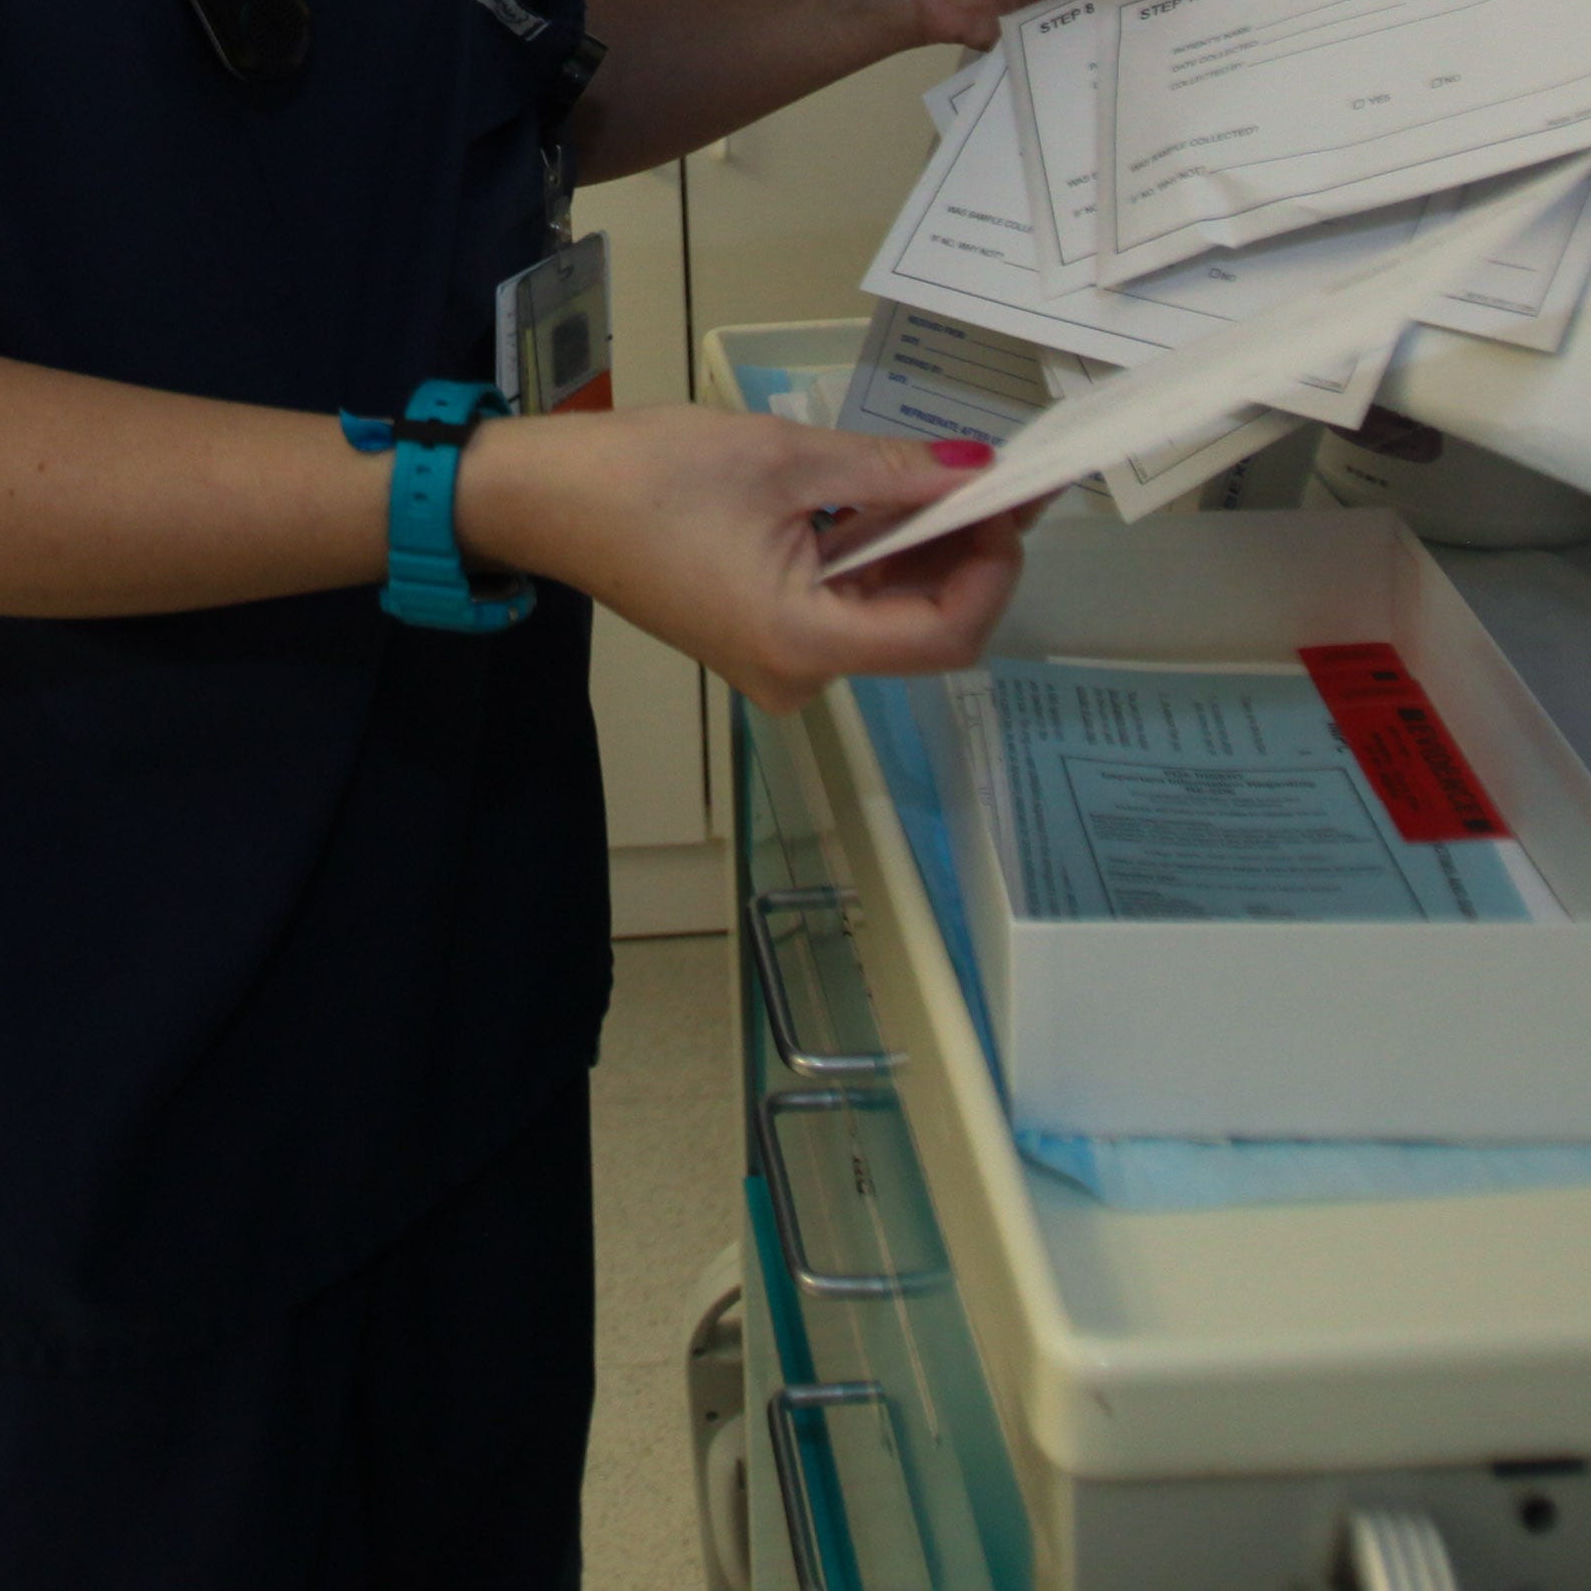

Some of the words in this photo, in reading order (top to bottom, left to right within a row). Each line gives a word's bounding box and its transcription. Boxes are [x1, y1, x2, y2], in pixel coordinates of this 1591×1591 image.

[1040, 7, 1082, 34] STEP
[1085, 2, 1096, 15] 8
[1369, 93, 1391, 105] YES
[1445, 74, 1462, 84] NO
[899, 403, 960, 434] REFRIGERATE
[961, 425, 991, 443] AFTER
